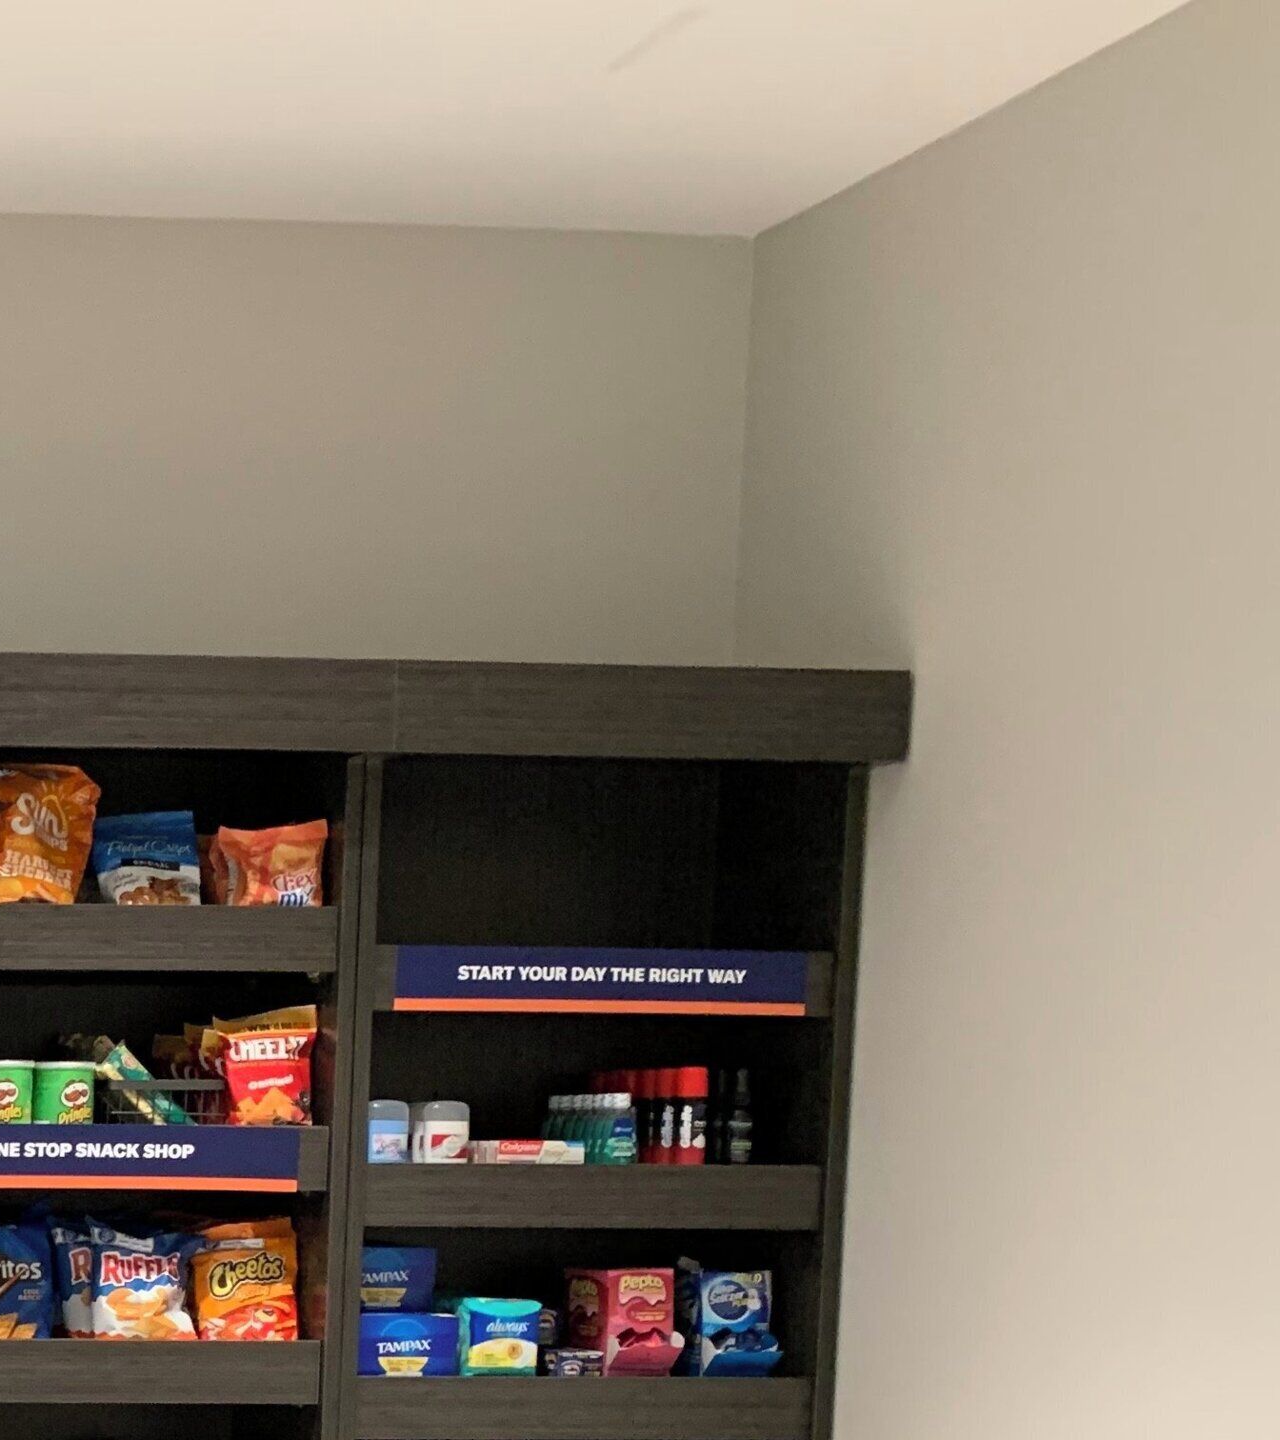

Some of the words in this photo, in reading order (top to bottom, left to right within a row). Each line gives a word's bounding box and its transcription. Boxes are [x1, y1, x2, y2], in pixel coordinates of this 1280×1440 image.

[457, 964, 515, 982] START
[518, 965, 568, 982] YOUR
[570, 966, 606, 983] DAY
[610, 967, 645, 983] THE
[648, 968, 704, 984] RIGHT
[707, 968, 746, 985] WAY
[23, 1142, 73, 1158] STOP
[75, 1142, 139, 1158] SNACK
[142, 1143, 195, 1159] SHOP
[210, 1254, 284, 1299] Cheetos
[486, 1319, 531, 1333] always
[376, 1339, 432, 1354] TAMPAX
